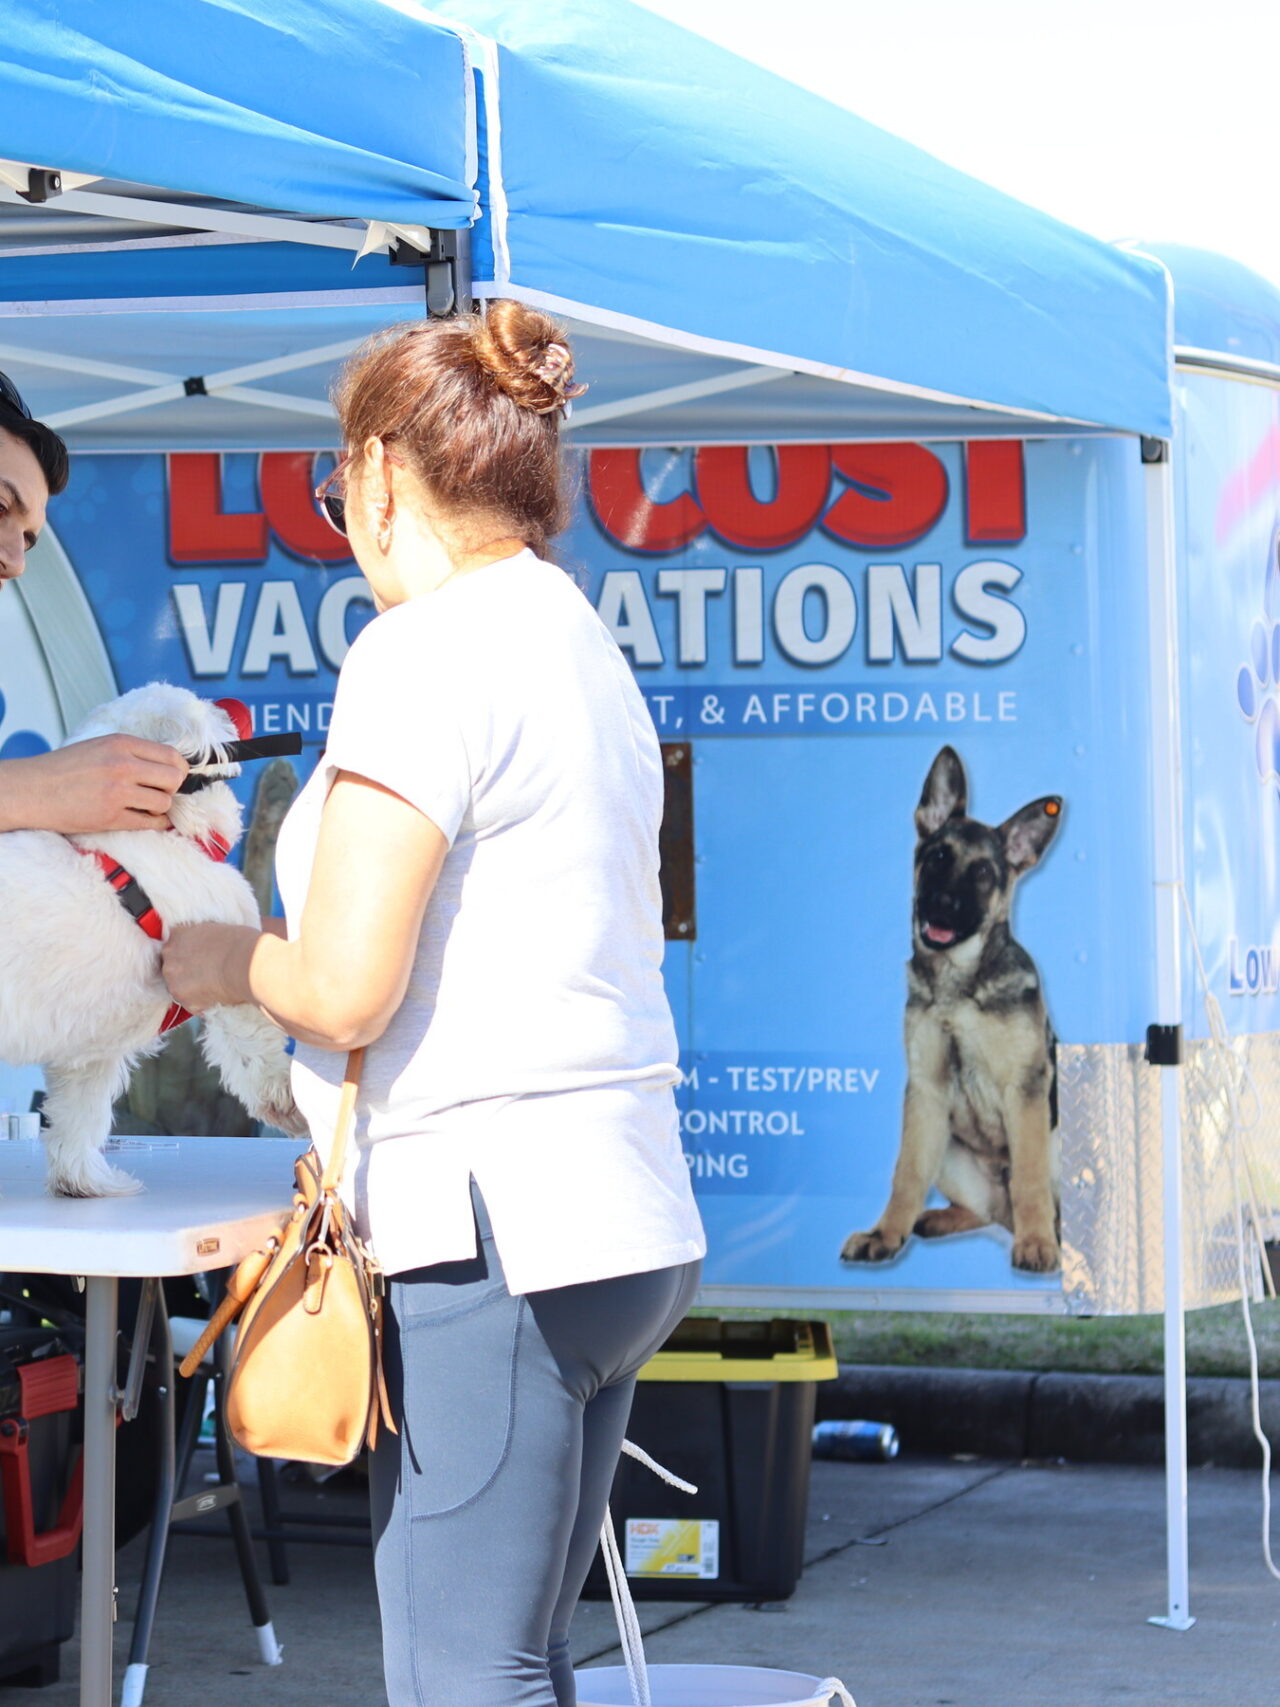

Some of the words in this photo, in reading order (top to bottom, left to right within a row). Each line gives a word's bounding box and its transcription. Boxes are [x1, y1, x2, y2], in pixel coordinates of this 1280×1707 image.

[700, 694, 725, 725] &
[742, 691, 1018, 726] AFFORDABLE
[726, 1066, 880, 1093] TEST/PREV
[678, 1109, 806, 1136] ONTROL
[630, 1523, 660, 1535] HDX
